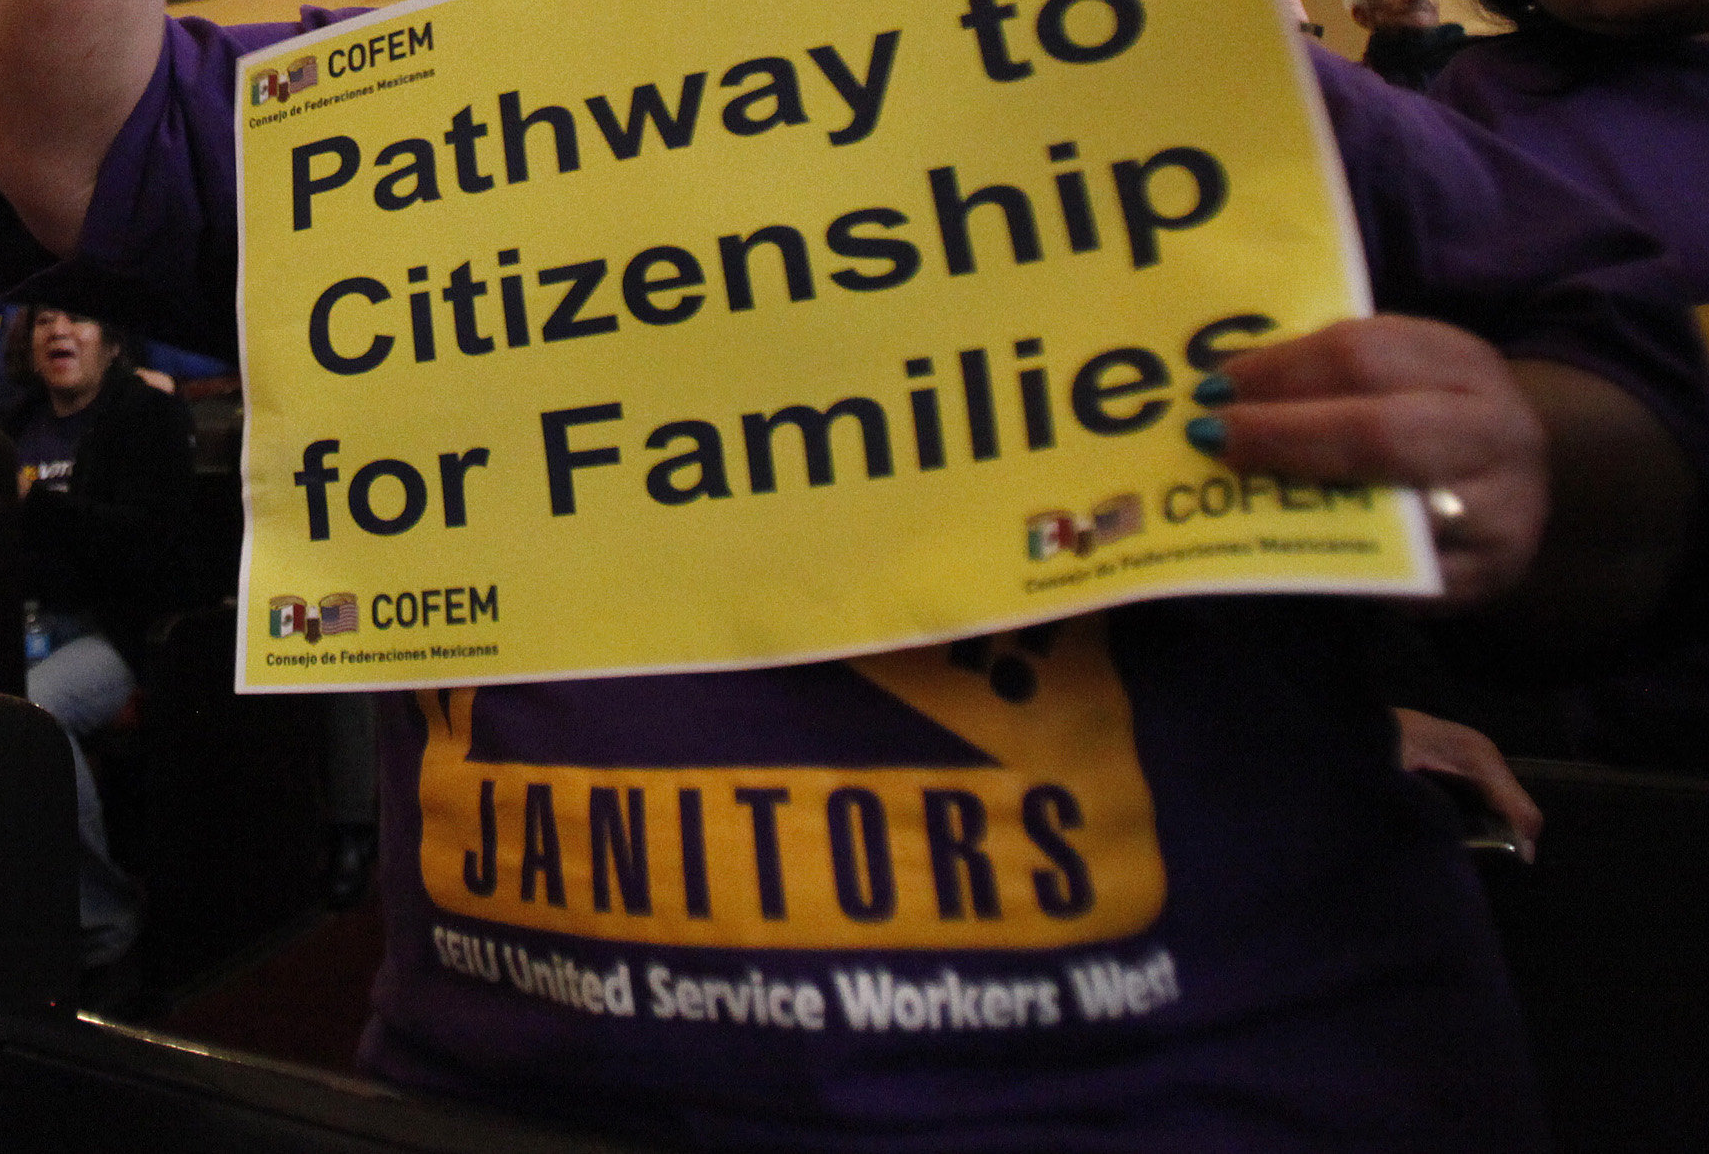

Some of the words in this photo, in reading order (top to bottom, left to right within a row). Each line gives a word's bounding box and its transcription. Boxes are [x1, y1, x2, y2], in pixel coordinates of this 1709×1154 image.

[327, 21, 435, 79] COFEM
[249, 110, 288, 129] Consejo
[290, 104, 303, 117] de
[305, 85, 375, 113] Federaciones
[377, 68, 436, 91] Mexicanas
[291, 29, 901, 232] Pathway
[307, 141, 1230, 376] Citizenship
[293, 438, 491, 542] for
[371, 584, 499, 630] COFEM
[266, 653, 318, 669] Consejo
[321, 651, 336, 664] de
[340, 648, 428, 665] Federaciones
[431, 644, 500, 660] Mexicanas
[461, 778, 1096, 925] JANITORS
[503, 943, 637, 1018] United
[647, 960, 827, 1031] Service
[831, 965, 1062, 1032] Workers
